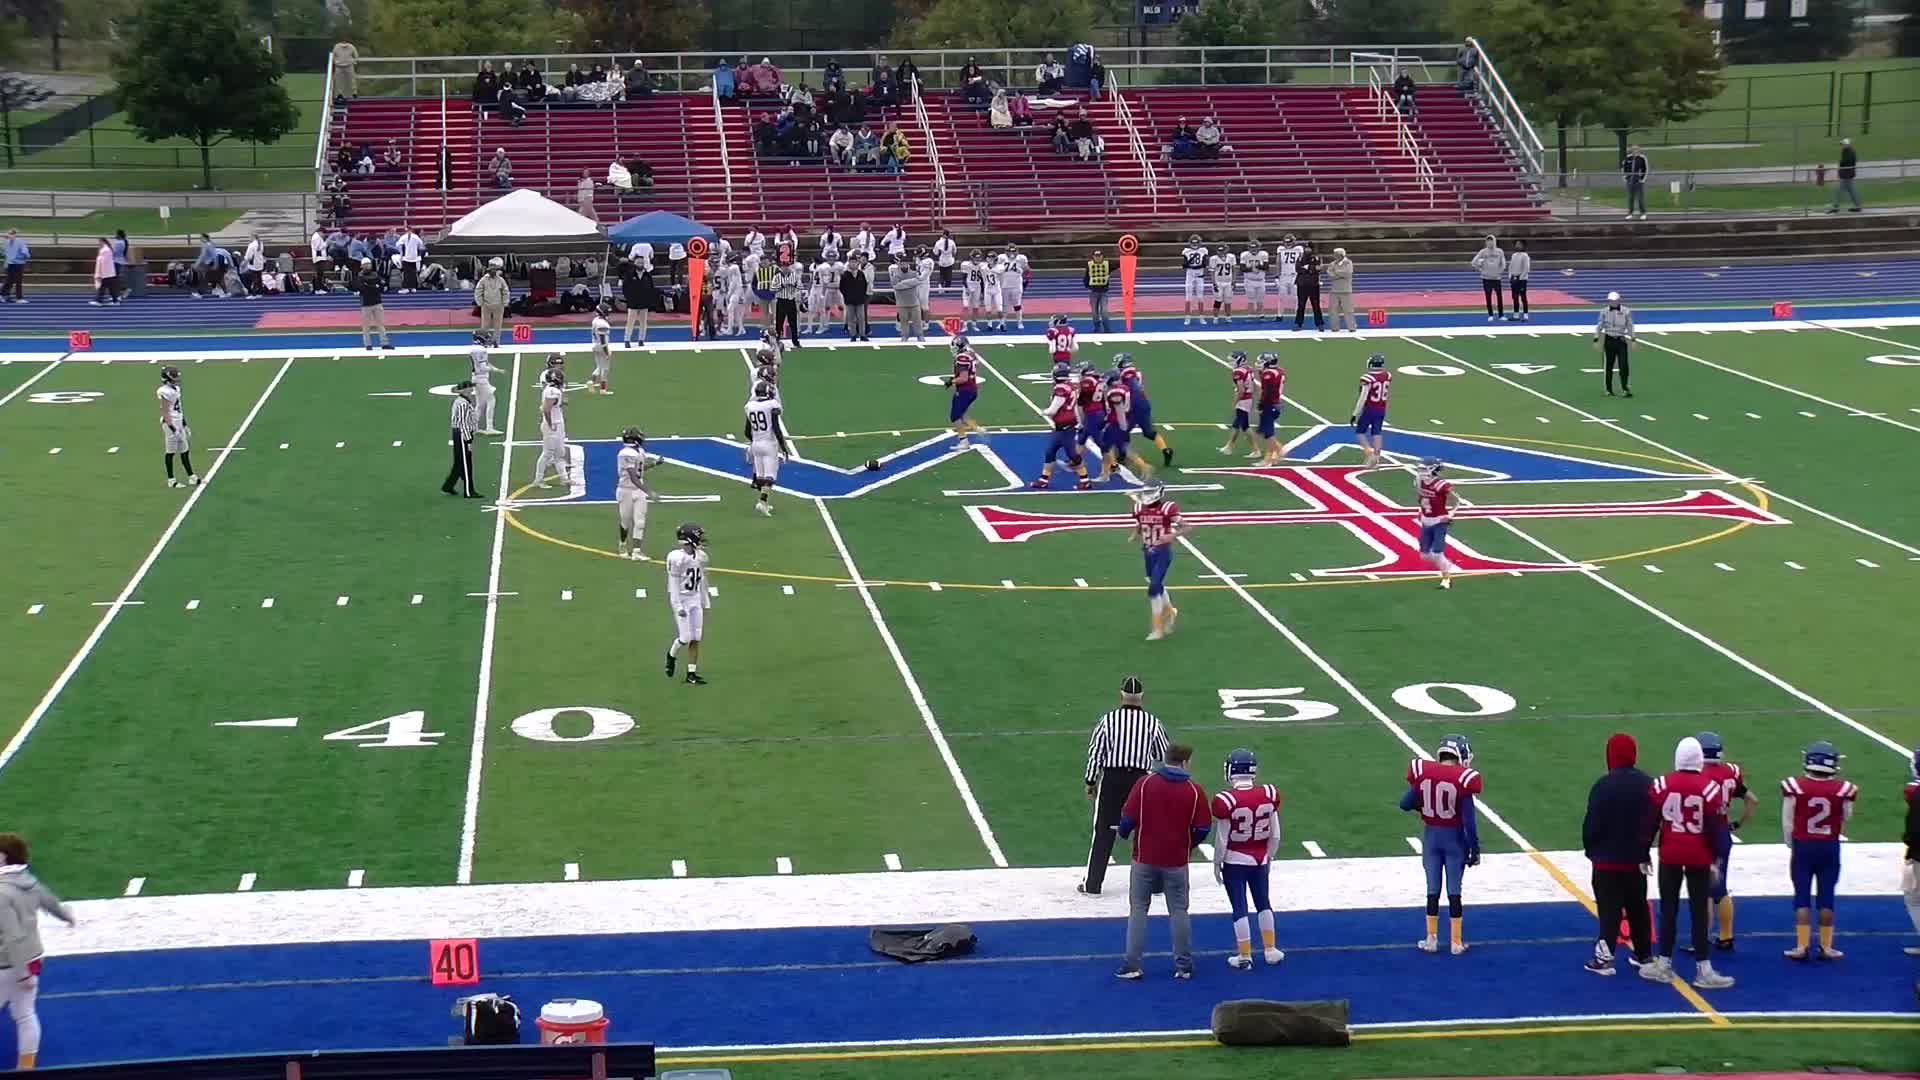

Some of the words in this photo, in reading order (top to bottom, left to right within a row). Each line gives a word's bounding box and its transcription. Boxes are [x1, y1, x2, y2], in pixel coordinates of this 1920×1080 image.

[779, 244, 791, 261] 2
[1216, 263, 1231, 276] 79
[514, 325, 529, 340] 40
[749, 410, 768, 432] 99
[1141, 524, 1166, 547] 20
[1419, 778, 1459, 820] 10
[1661, 791, 1704, 834] 43
[1229, 802, 1275, 843] 32
[1807, 796, 1832, 836] 2
[435, 942, 475, 979] 40
